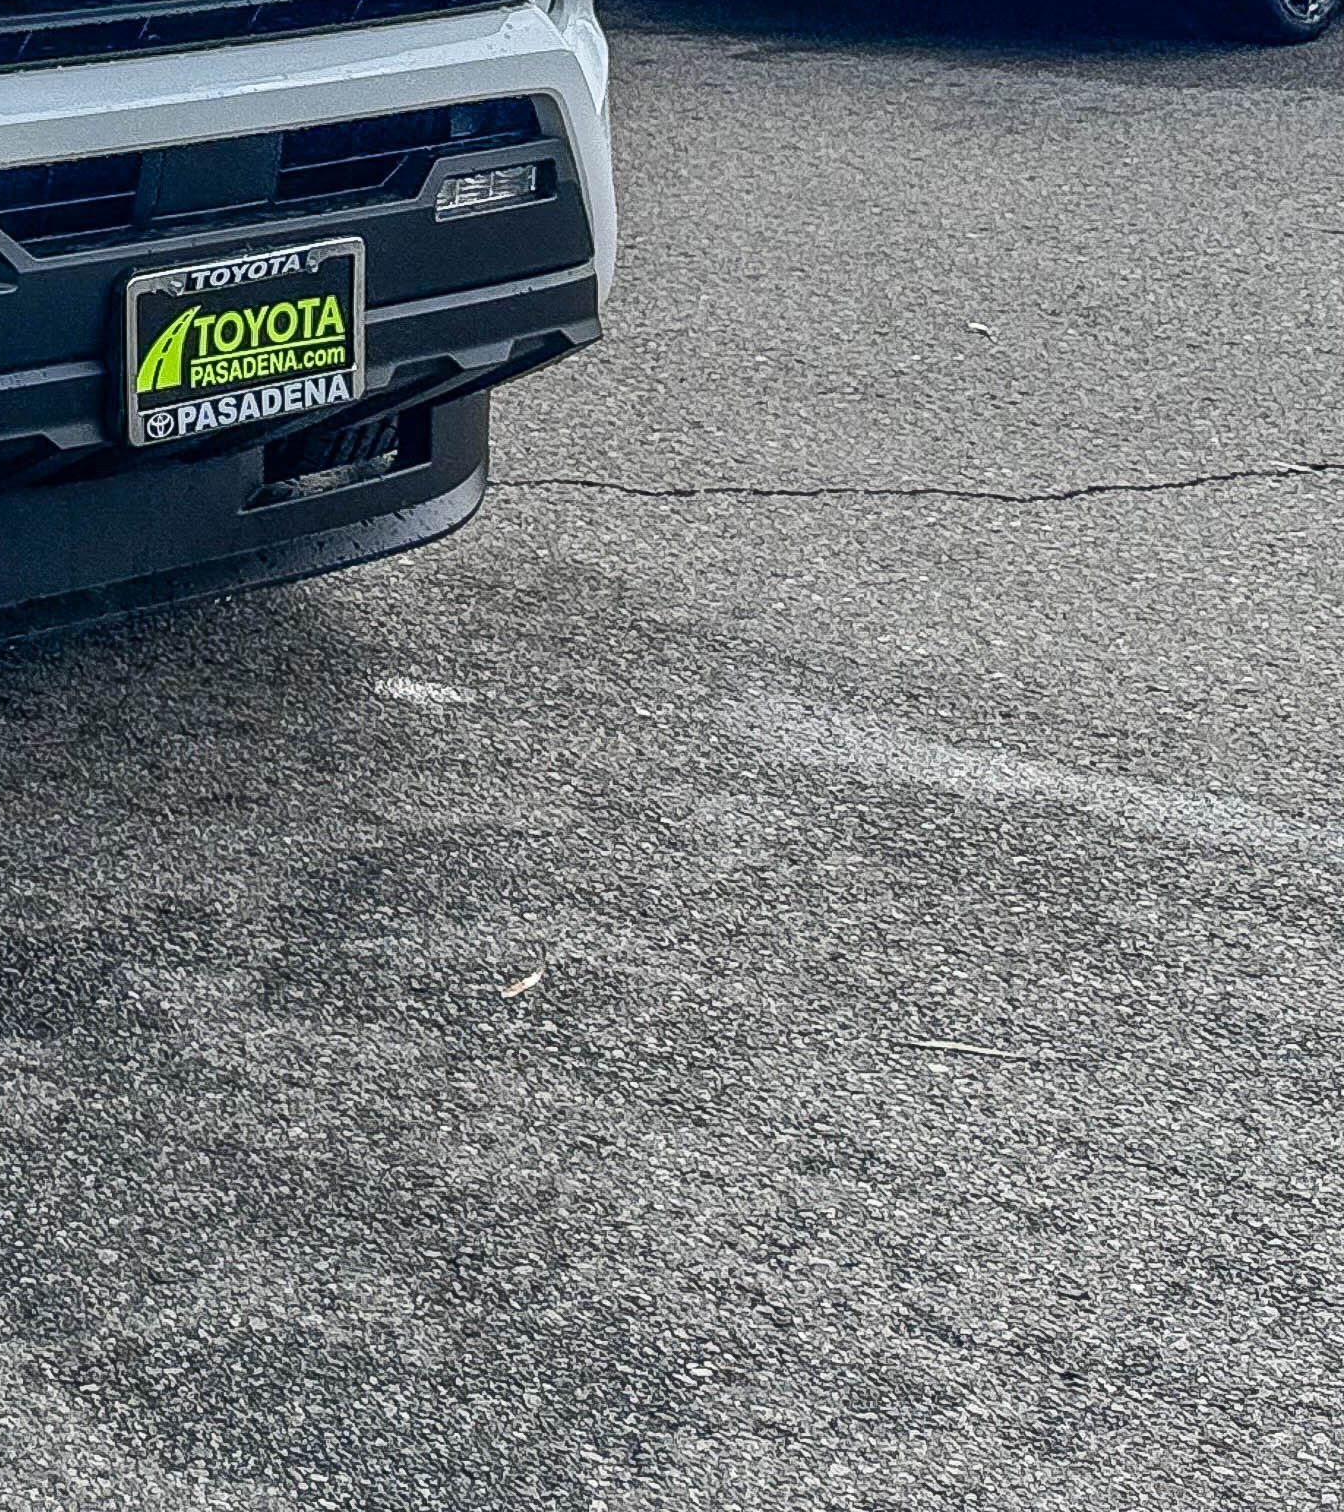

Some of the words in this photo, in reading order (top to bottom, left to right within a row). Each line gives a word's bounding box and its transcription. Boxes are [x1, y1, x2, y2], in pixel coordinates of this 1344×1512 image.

[190, 254, 301, 291] TOYOTA
[193, 295, 345, 356] TOYOTA
[190, 345, 346, 388] PASADENA.com
[177, 374, 351, 434] PASADENA
